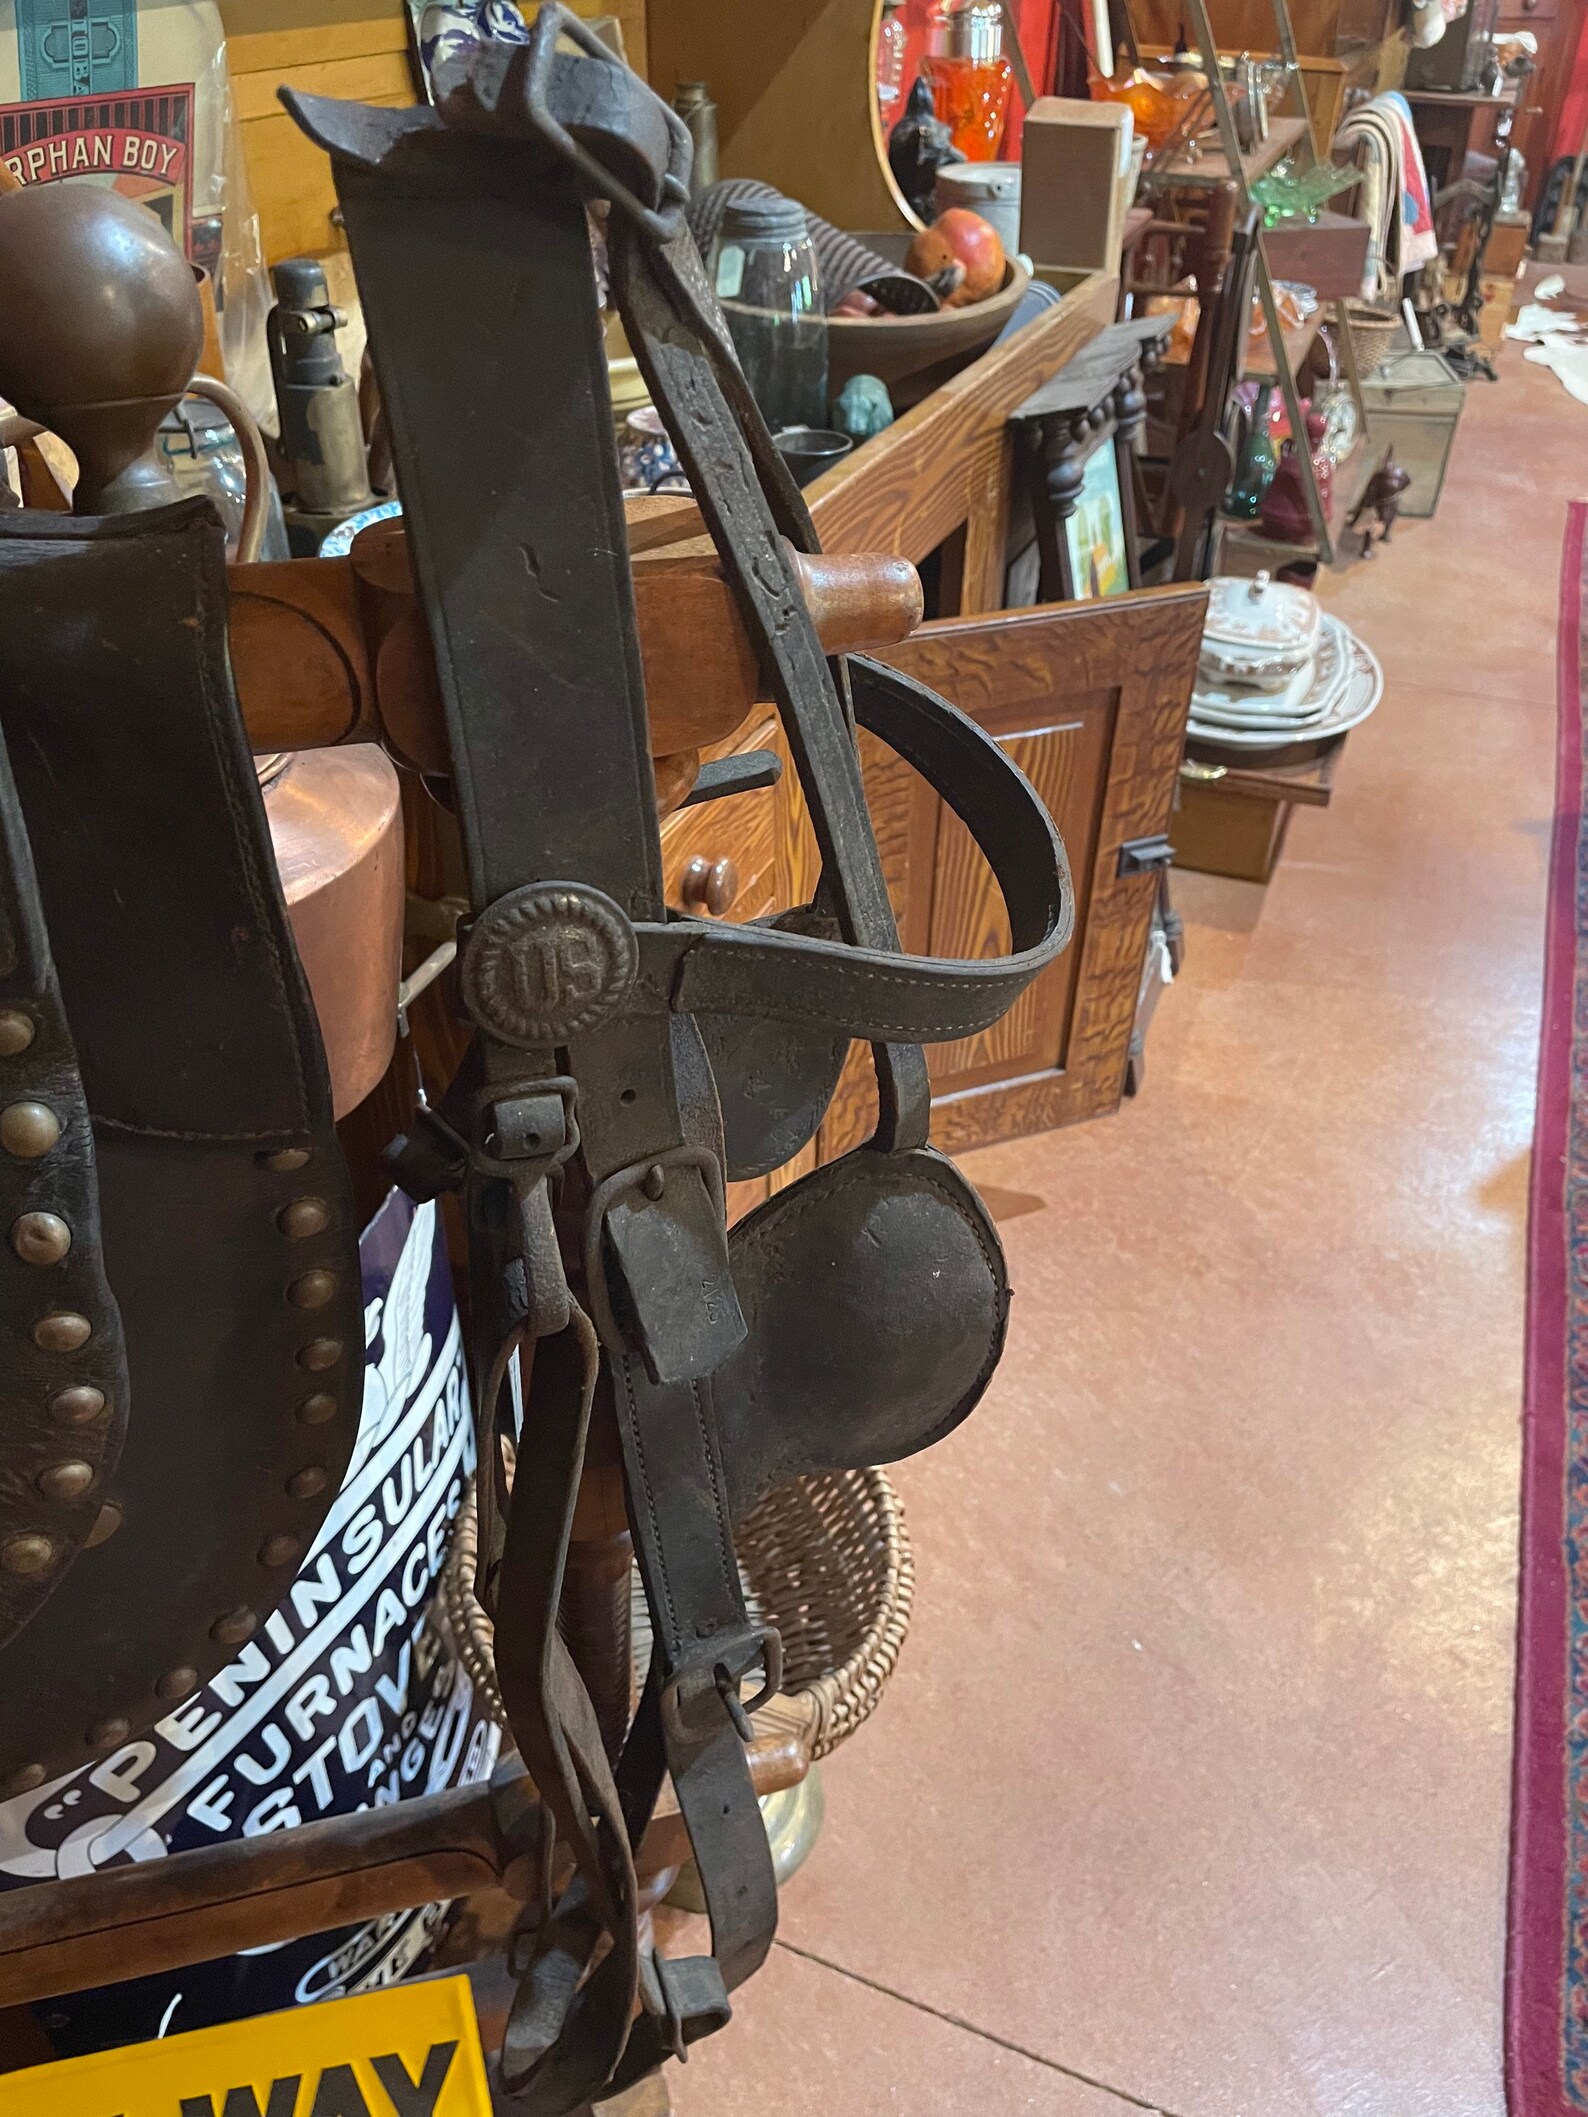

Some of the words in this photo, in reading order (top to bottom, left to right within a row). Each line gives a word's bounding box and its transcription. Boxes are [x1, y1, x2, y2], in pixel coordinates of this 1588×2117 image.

[4, 134, 113, 187] RPHAN
[122, 135, 177, 176] BOY
[367, 1710, 419, 1789] AND
